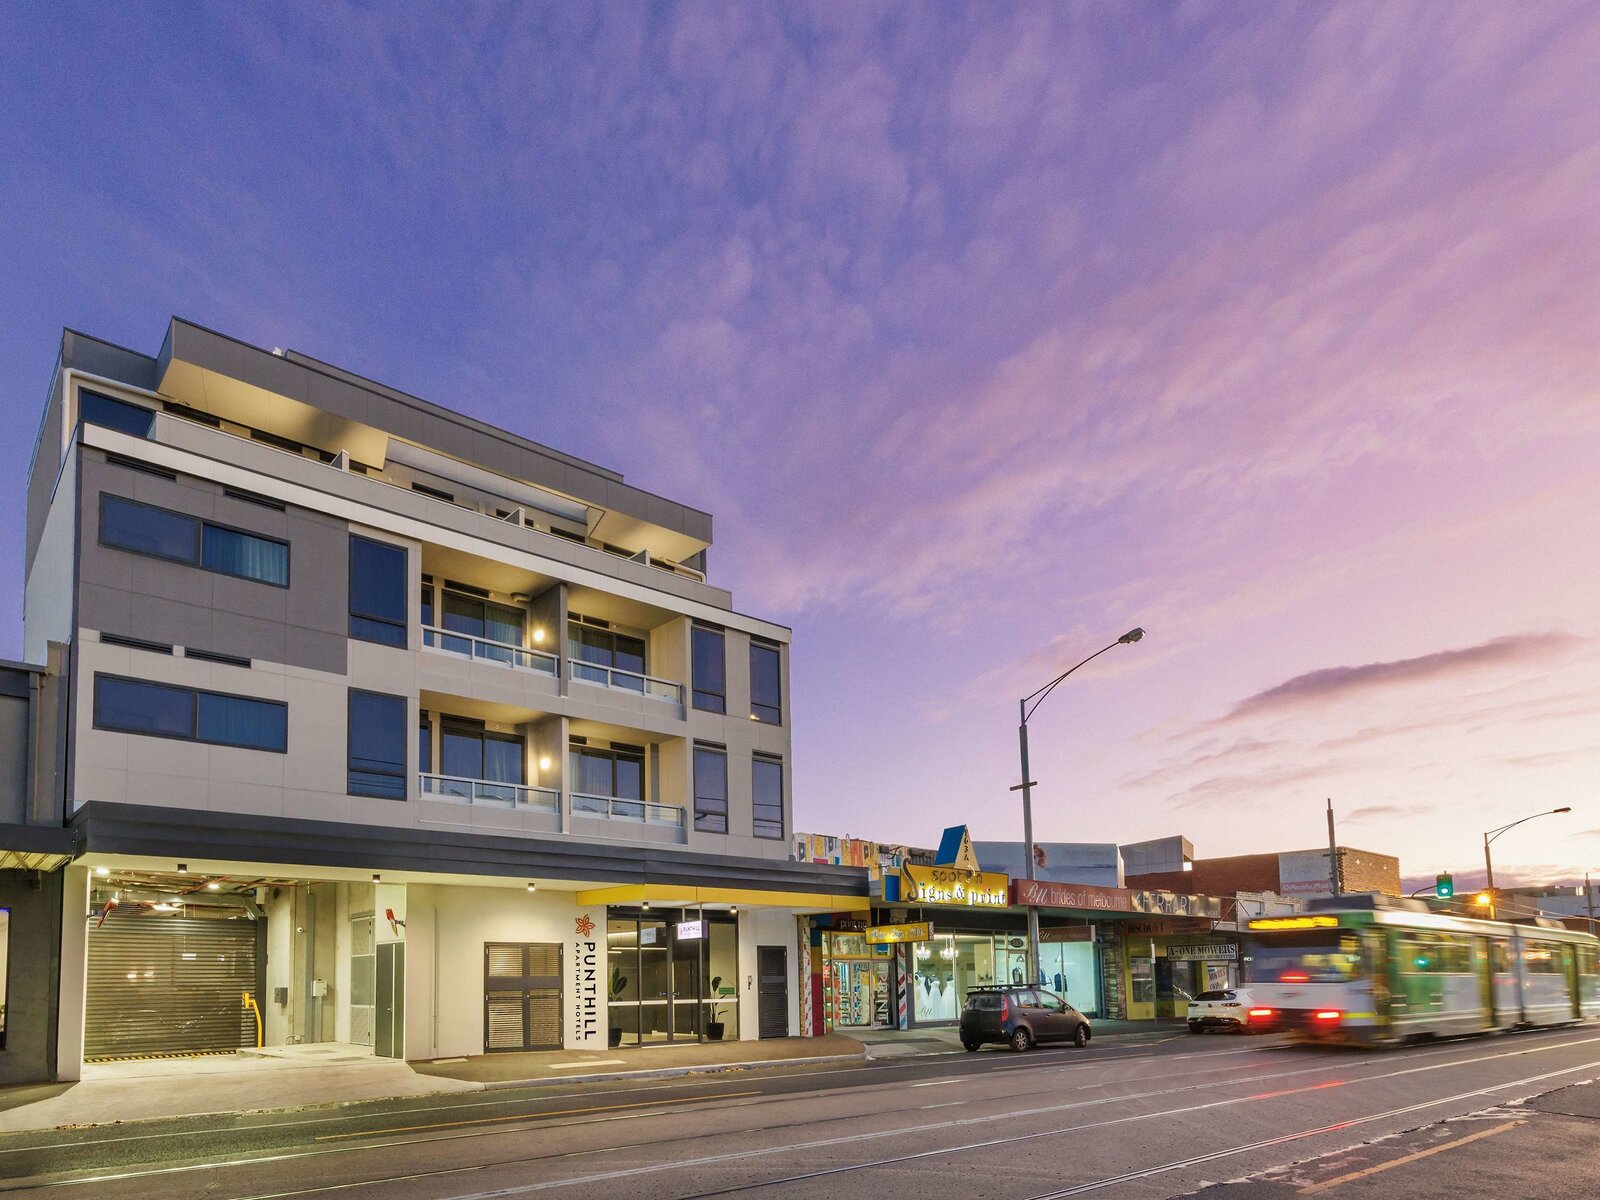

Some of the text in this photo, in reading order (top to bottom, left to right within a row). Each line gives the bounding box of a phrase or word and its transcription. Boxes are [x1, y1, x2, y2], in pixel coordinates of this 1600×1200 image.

[901, 857, 952, 902] Signs
[1050, 887, 1076, 906] brides
[1077, 890, 1087, 906] of
[1088, 893, 1127, 910] melbourne
[1197, 944, 1235, 954] MOWERS
[584, 942, 597, 1040] PUNTHILL
